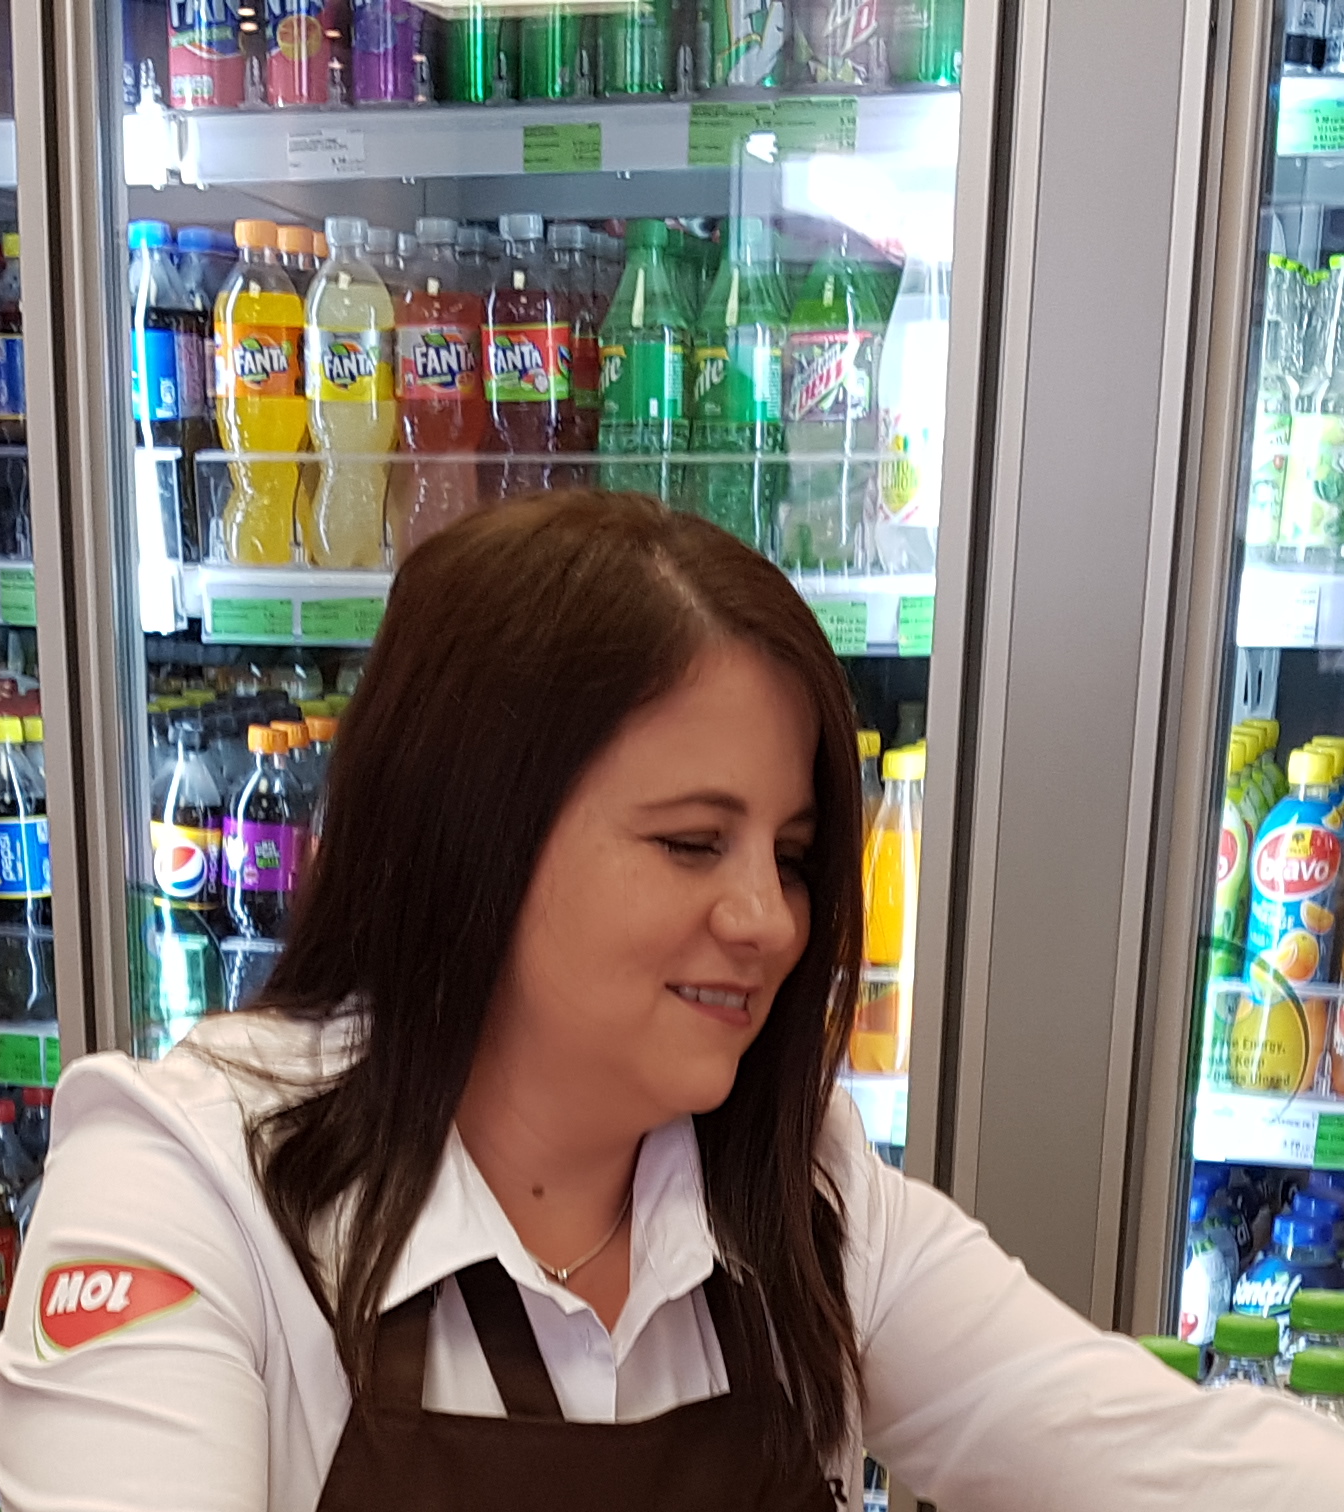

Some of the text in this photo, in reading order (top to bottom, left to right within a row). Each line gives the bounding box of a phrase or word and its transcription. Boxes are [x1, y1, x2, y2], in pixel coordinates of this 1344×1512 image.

[235, 344, 290, 376] FANTA
[323, 349, 376, 379] FANTA
[414, 343, 475, 377] FANTA
[490, 343, 543, 374] FANTA
[46, 1270, 134, 1317] MOL
